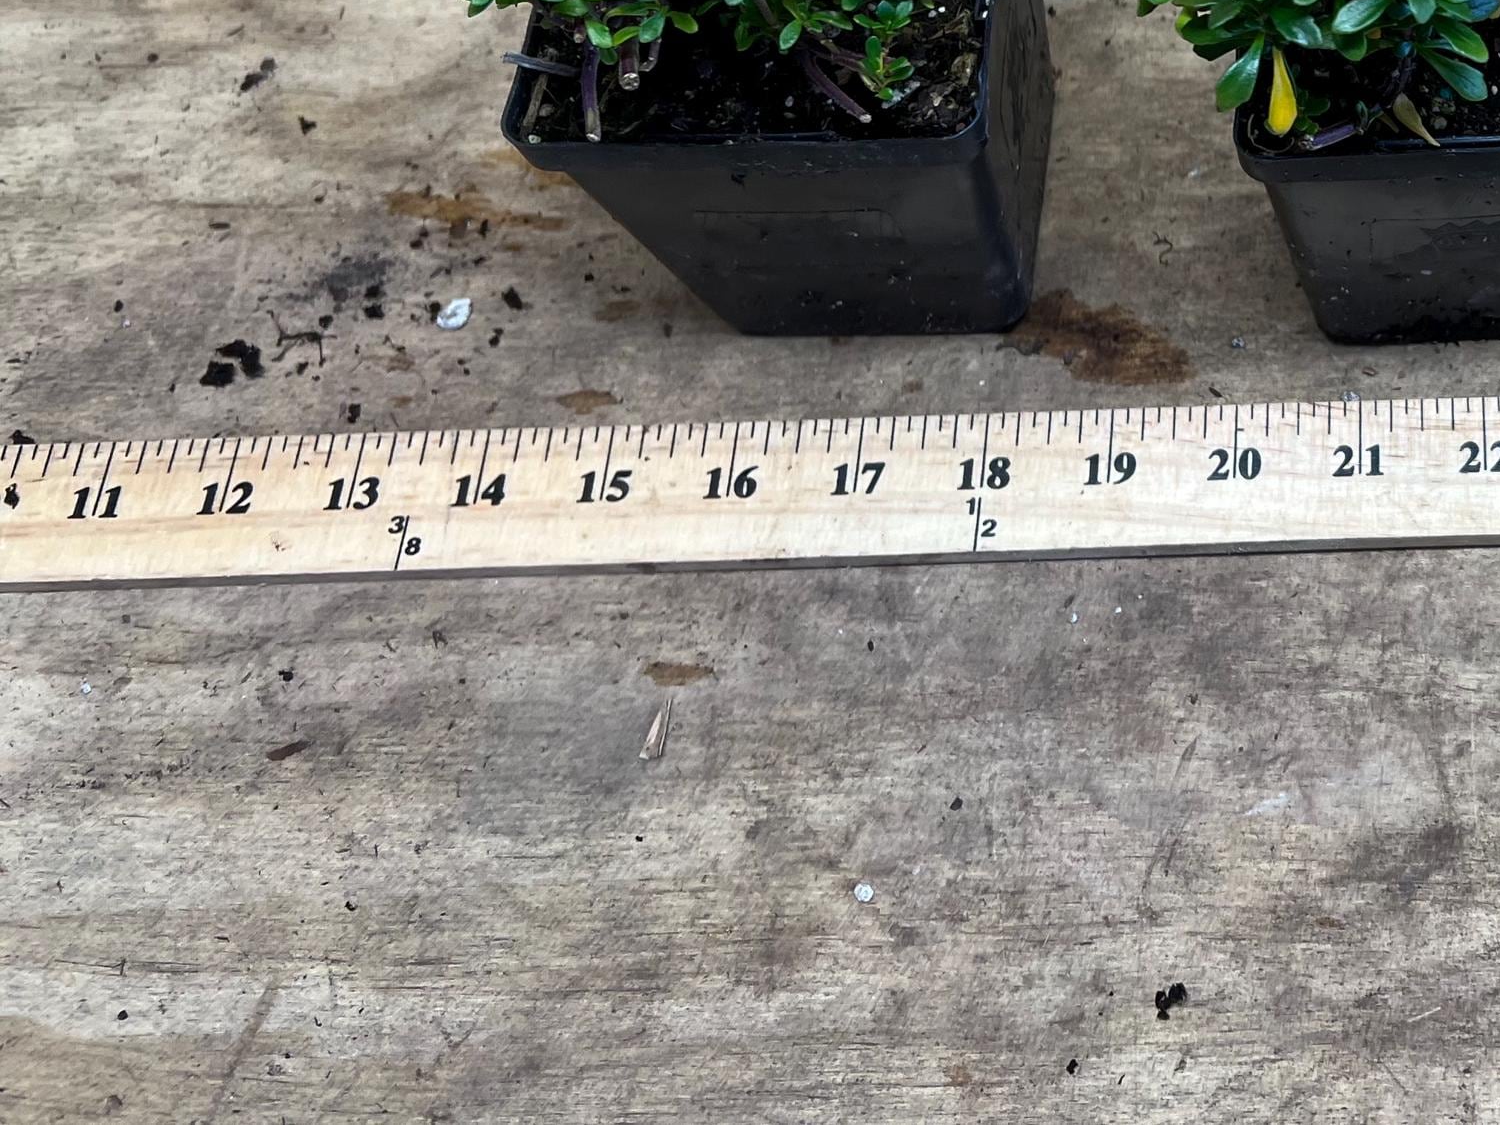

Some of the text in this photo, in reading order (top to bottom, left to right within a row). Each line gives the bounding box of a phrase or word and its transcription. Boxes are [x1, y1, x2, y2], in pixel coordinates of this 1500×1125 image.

[66, 485, 122, 520] 11
[195, 481, 254, 516] 12
[322, 476, 380, 511] 13
[449, 473, 506, 508] 14
[575, 469, 633, 504] 15
[702, 465, 759, 500] 16
[830, 461, 886, 496] 17
[956, 456, 1011, 491] 18
[1083, 451, 1137, 486] 19
[1206, 447, 1262, 481] 20
[1332, 444, 1384, 478] 21
